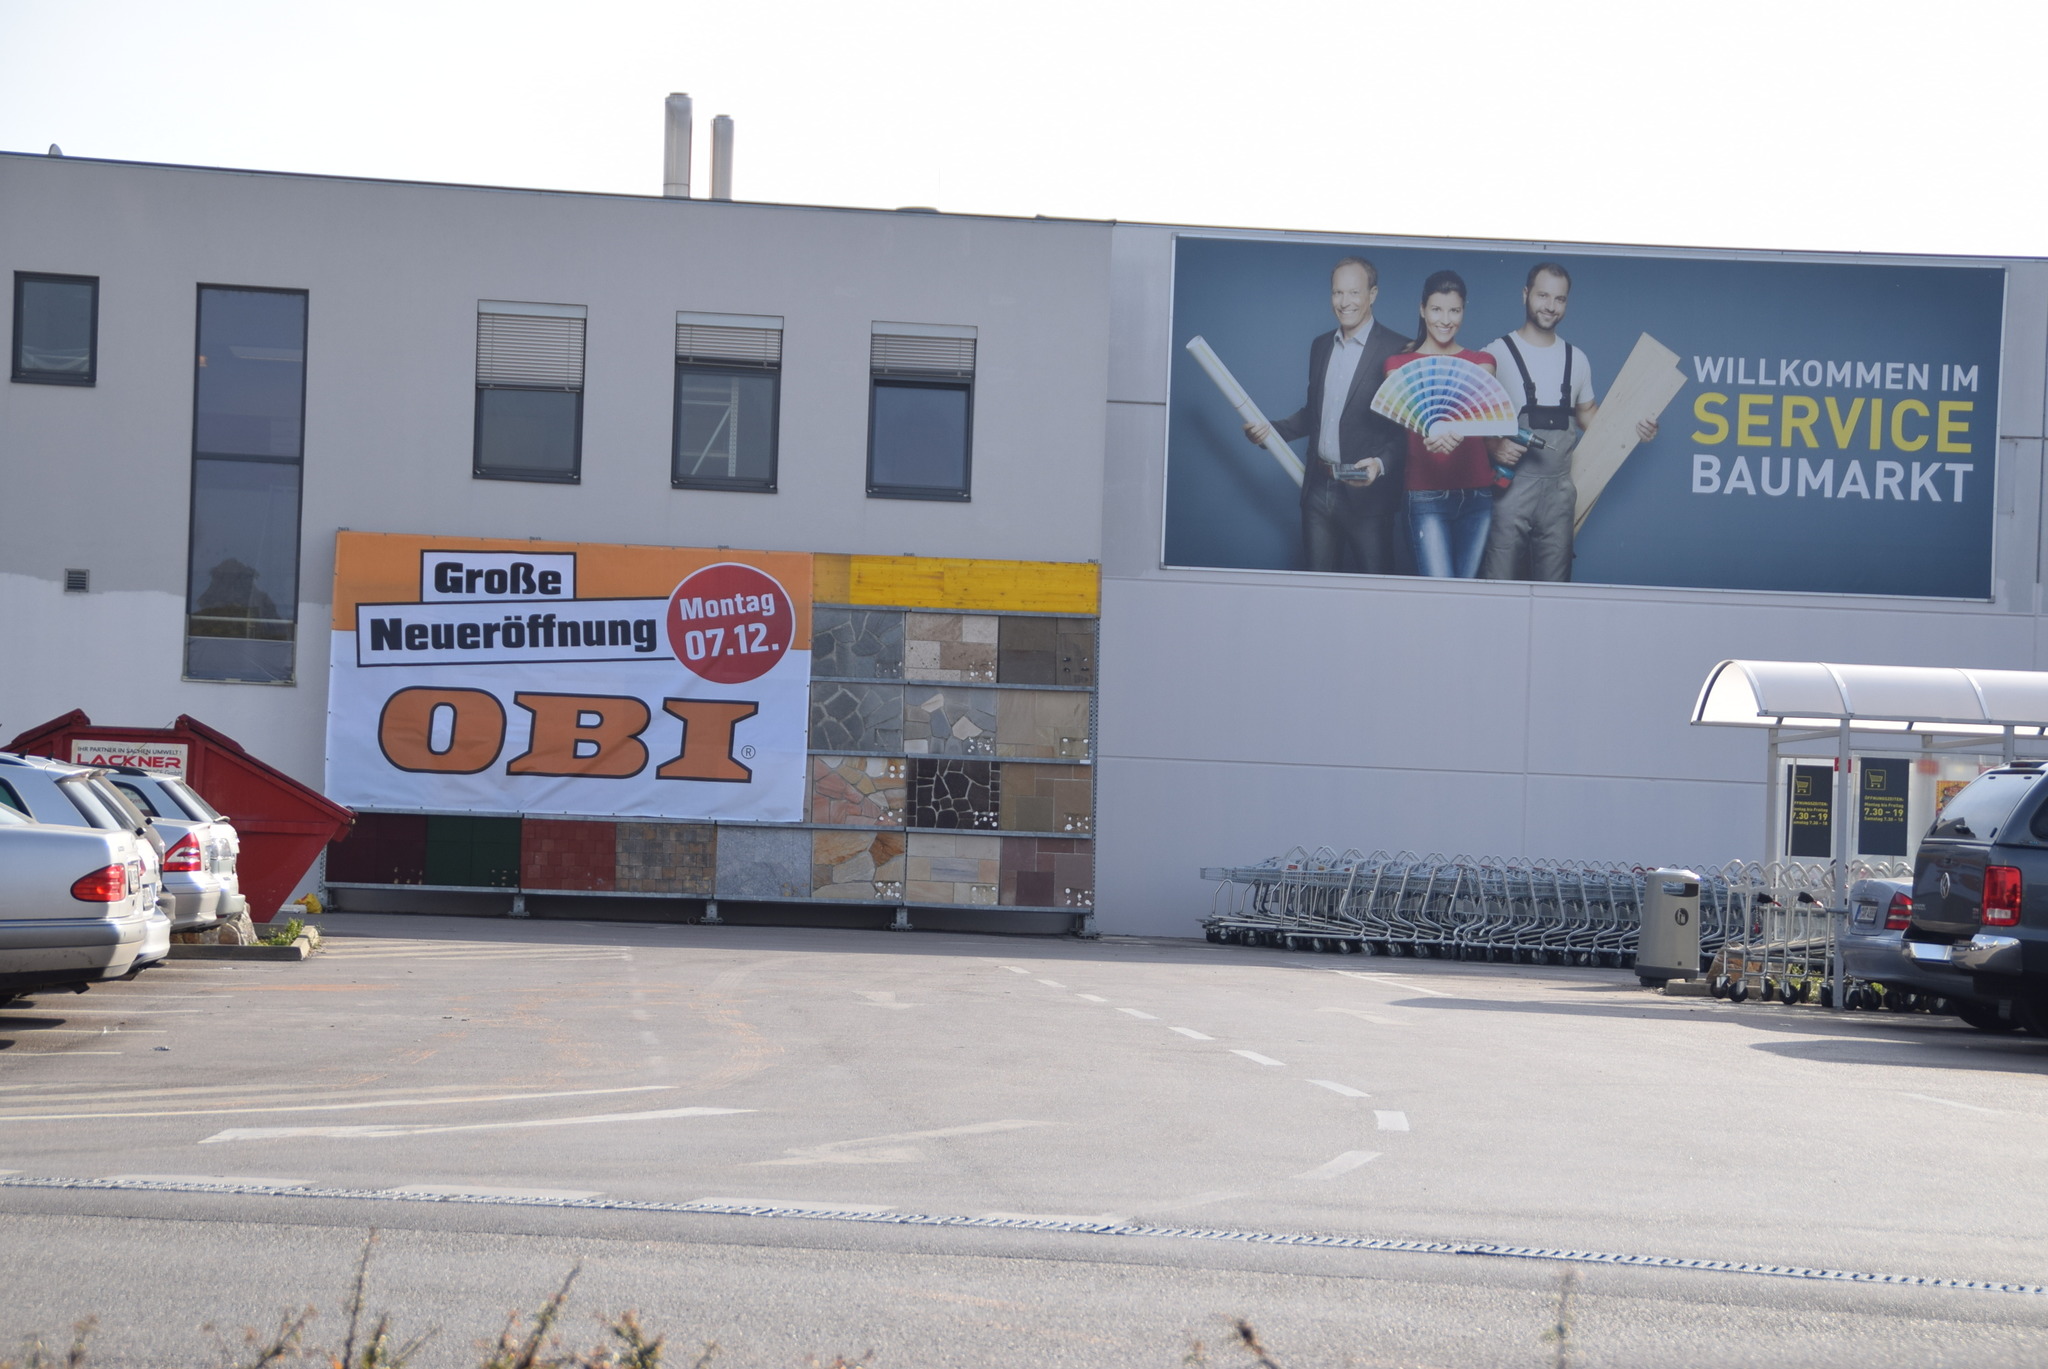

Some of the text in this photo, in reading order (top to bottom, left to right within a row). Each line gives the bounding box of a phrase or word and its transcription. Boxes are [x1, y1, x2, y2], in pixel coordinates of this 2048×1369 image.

[1693, 356, 1978, 392] WILLKOMMEN IM
[1691, 392, 1974, 453] SERVICE
[1692, 454, 1974, 502] BAUMARKT
[434, 562, 562, 595] Große
[680, 591, 776, 621] Montag
[370, 613, 657, 653] Neueröffnung
[685, 622, 779, 661] 07.12.
[378, 685, 759, 783] OBI
[77, 753, 182, 769] LACKNER
[1818, 813, 1828, 821] 19
[1864, 807, 1883, 816] 7.30
[1893, 808, 1904, 817] 19
